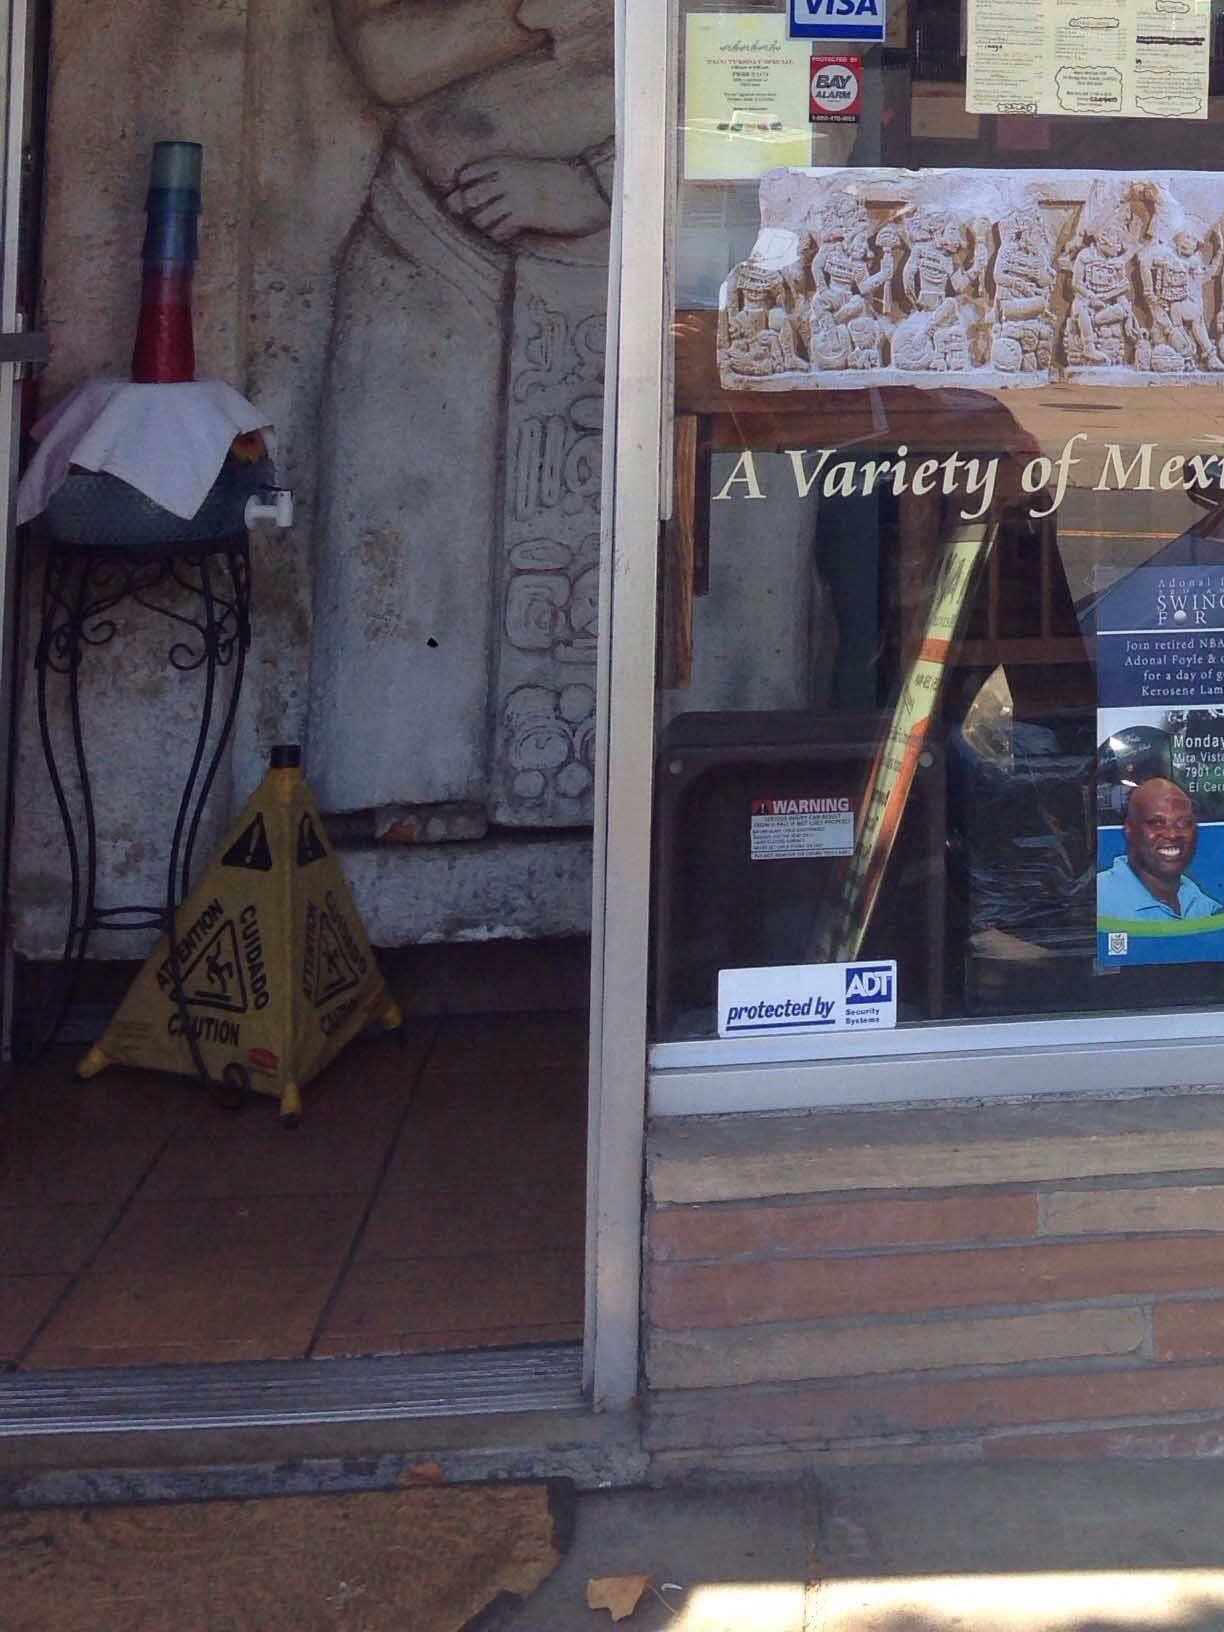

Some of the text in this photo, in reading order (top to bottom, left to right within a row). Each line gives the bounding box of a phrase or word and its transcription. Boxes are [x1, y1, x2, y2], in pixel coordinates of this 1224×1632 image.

[815, 74, 852, 90] BAY
[815, 90, 851, 100] ALARM
[713, 450, 767, 500] A
[785, 444, 1000, 520] Variety
[1021, 433, 1088, 519] of
[1158, 578, 1211, 588] Adonal
[1126, 641, 1150, 652] Join
[1155, 639, 1195, 651] retired
[1124, 654, 1167, 667] Adonal
[1172, 654, 1203, 668] Foyle
[1207, 654, 1217, 663] &
[1143, 670, 1162, 681] for
[1175, 670, 1197, 684] day
[1200, 669, 1214, 680] of
[1141, 685, 1195, 697] Kerosene
[1185, 766, 1210, 778] 7901
[1188, 782, 1199, 793] El
[773, 797, 849, 814] WARNING
[240, 904, 270, 1011] CUIDADO
[845, 968, 891, 998] ADT
[726, 996, 836, 1025] protected by
[845, 1007, 881, 1017] Security
[845, 1016, 881, 1025] Systems
